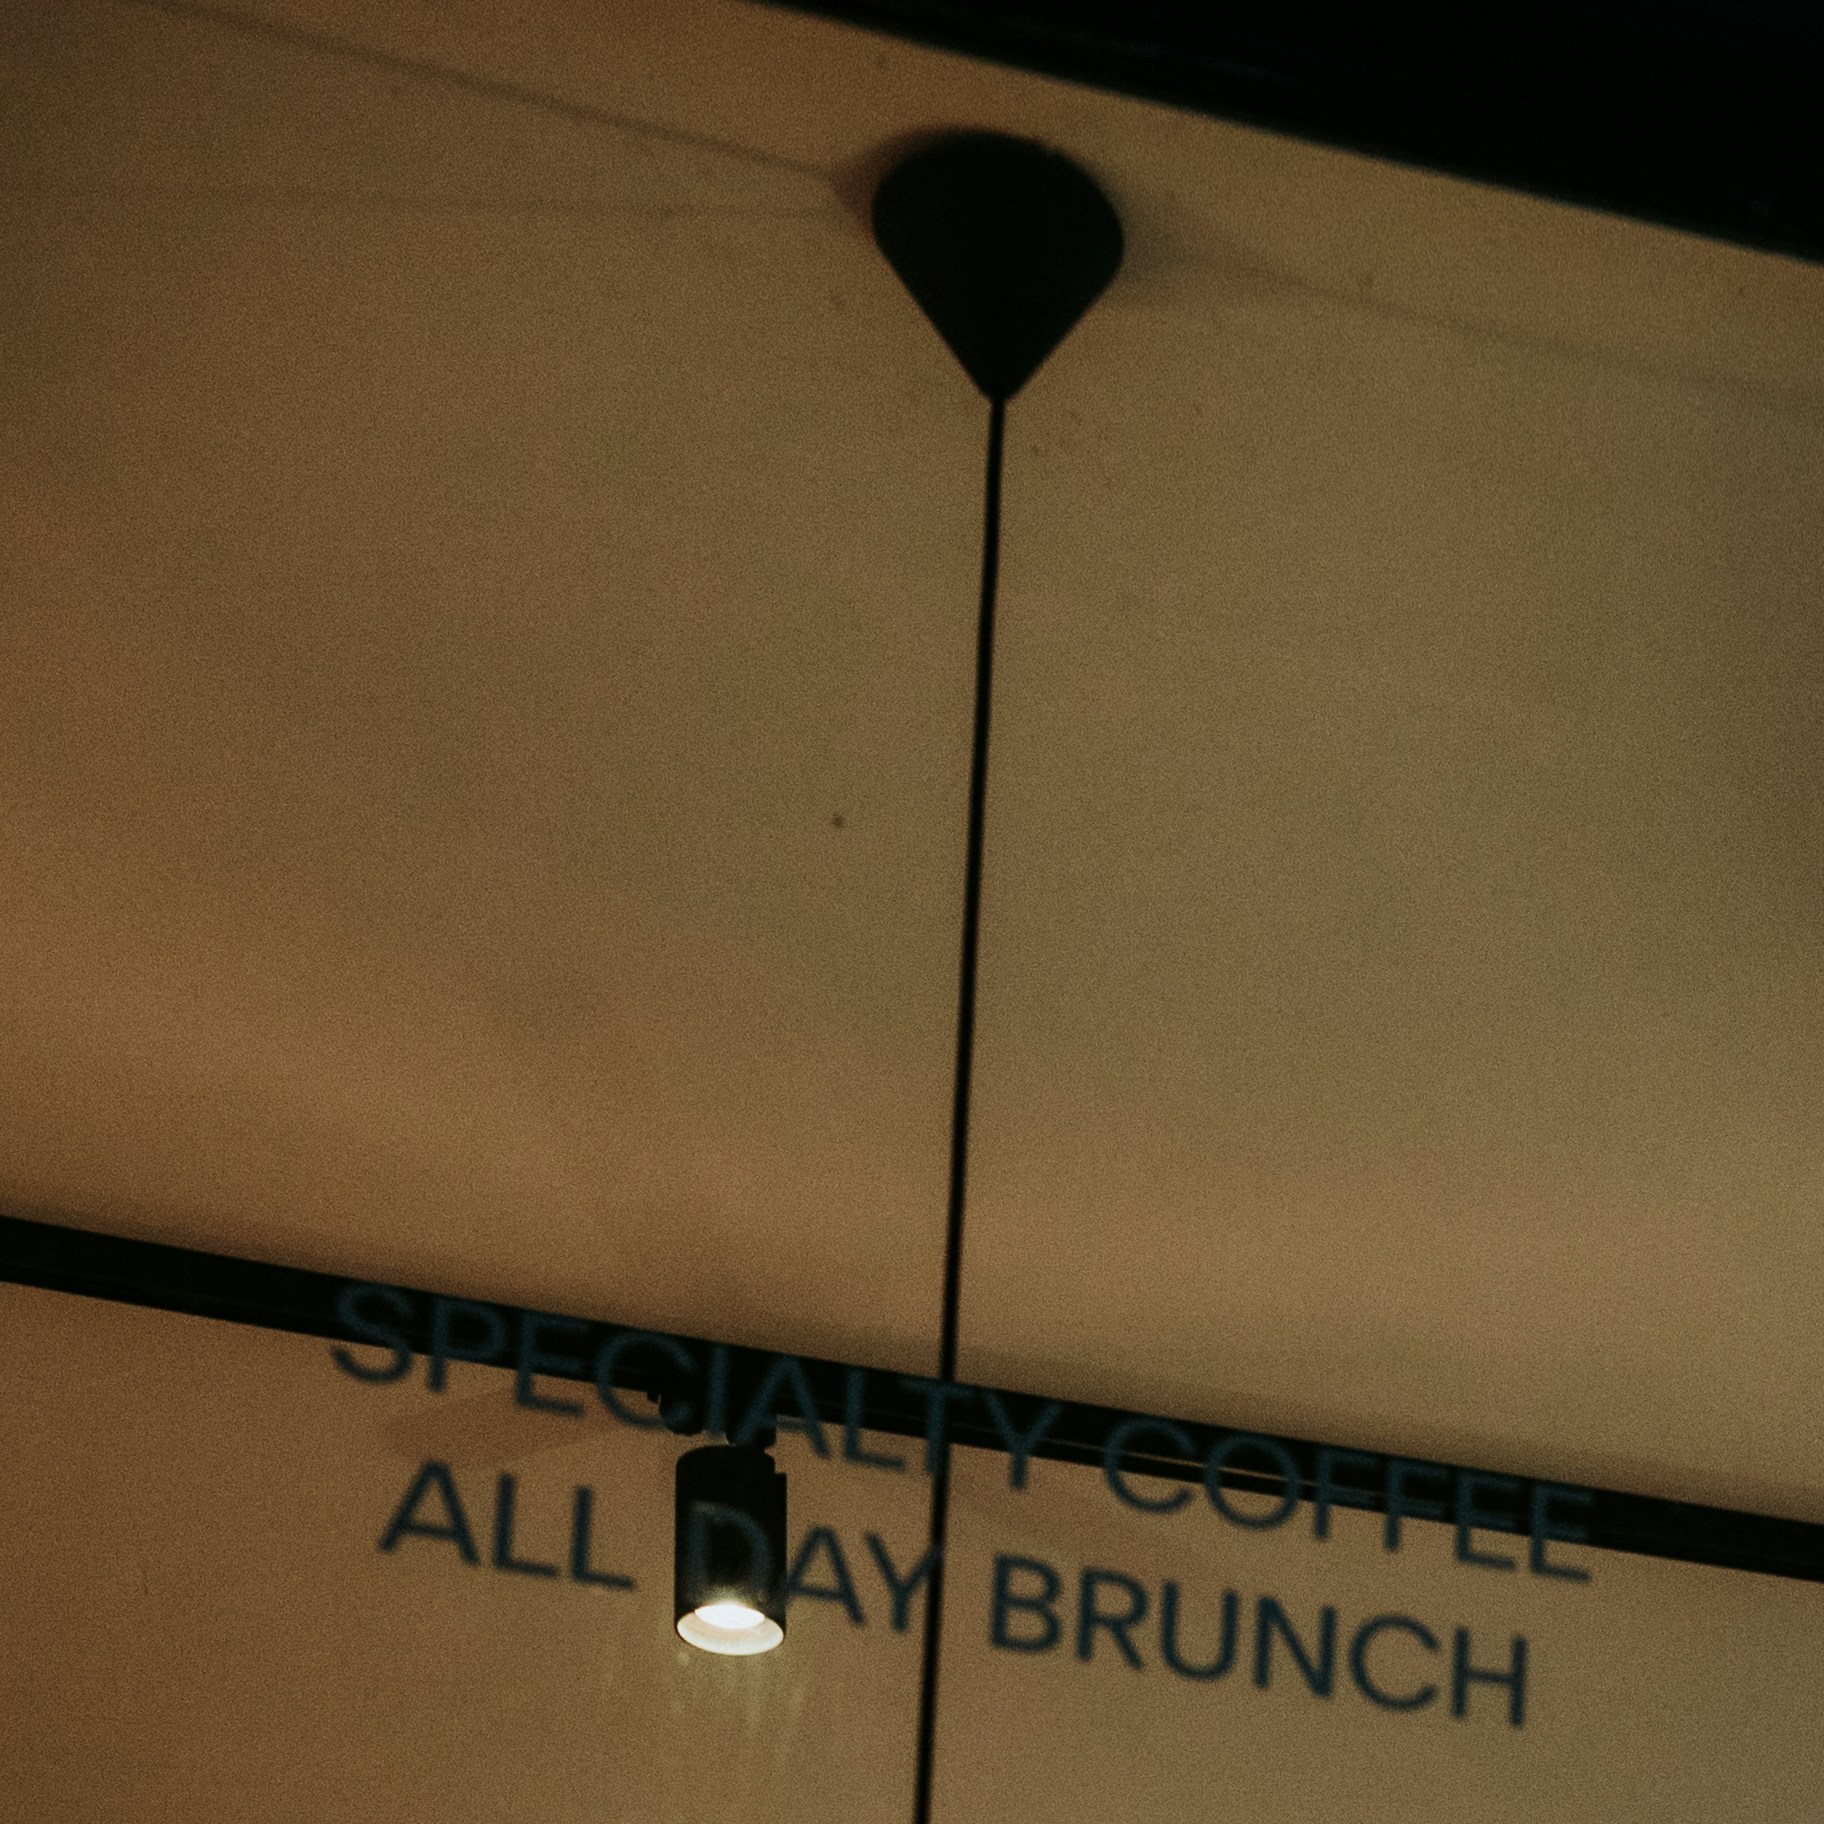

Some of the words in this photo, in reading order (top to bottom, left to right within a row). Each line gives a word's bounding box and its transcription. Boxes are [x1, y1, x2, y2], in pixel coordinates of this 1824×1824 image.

[332, 1283, 1062, 1490] SPECIALTY
[1103, 1416, 1596, 1582] COFFEE
[378, 1459, 637, 1591] ALL
[690, 1503, 944, 1633] DAY
[990, 1551, 1528, 1728] BRUNCH
